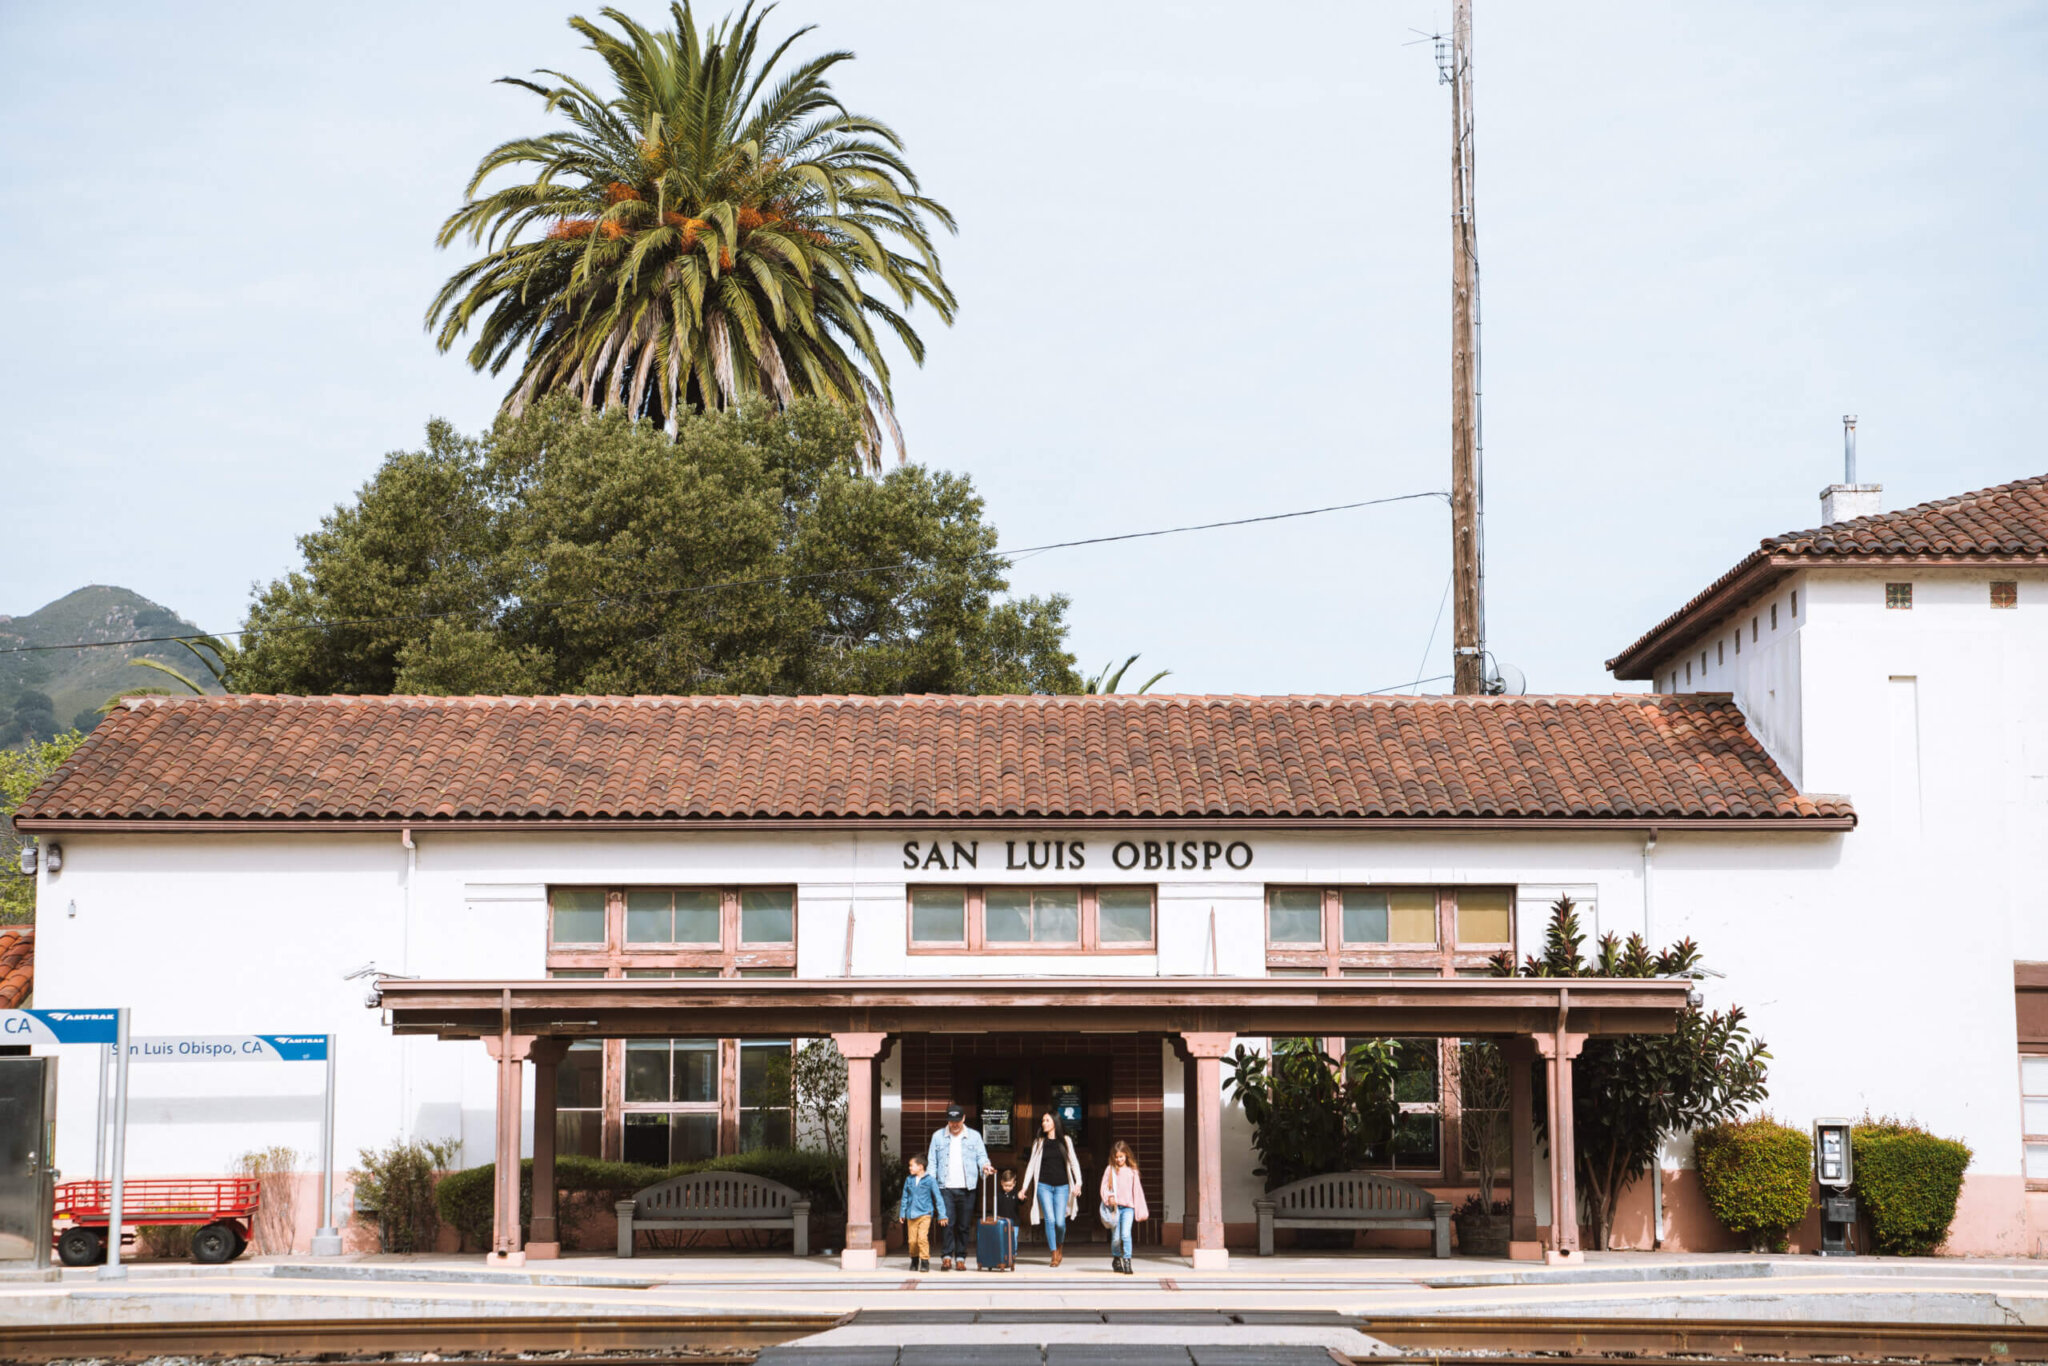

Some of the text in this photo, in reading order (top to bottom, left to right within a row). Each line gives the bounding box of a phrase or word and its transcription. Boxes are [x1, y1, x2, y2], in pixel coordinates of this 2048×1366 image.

[904, 841, 1254, 870] SAN LUIS OBISPO
[4, 1018, 32, 1034] CA
[111, 1041, 263, 1057] Sn Luis Obispo, CA
